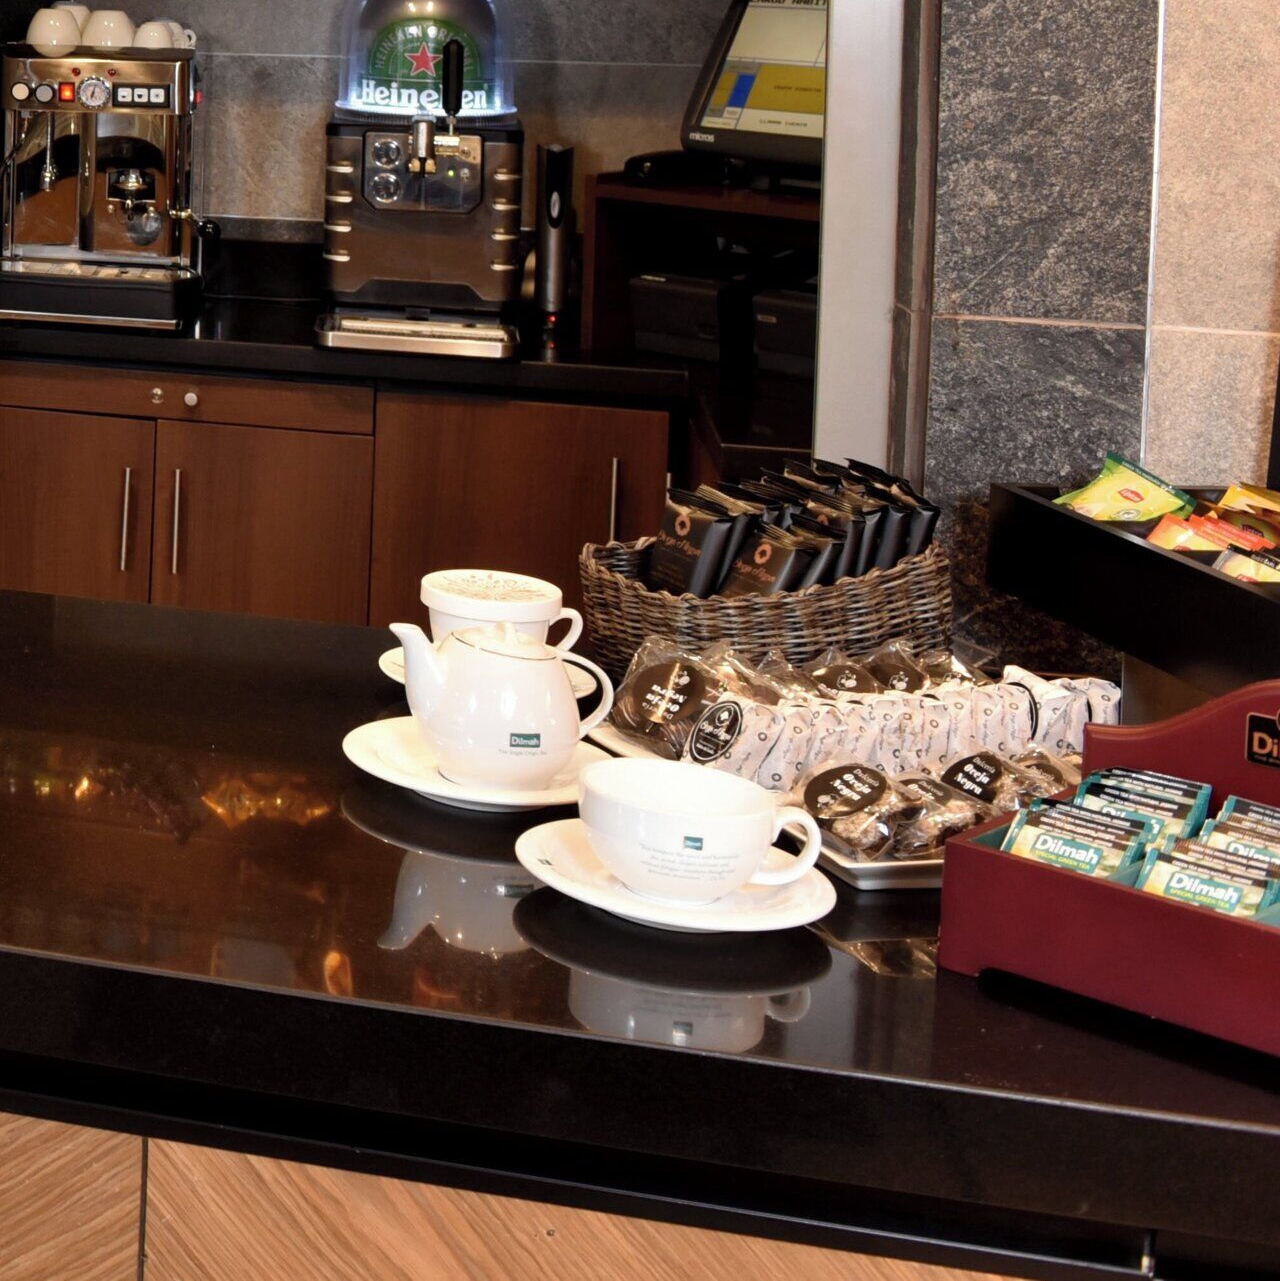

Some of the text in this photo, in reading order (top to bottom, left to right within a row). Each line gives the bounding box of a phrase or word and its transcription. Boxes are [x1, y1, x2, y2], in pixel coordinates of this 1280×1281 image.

[375, 25, 423, 69] HEINEKEN
[362, 79, 487, 109] Heineen
[689, 132, 715, 143] micros
[511, 735, 540, 746] Dilmah
[842, 773, 872, 795] Oreja
[954, 773, 983, 795] Negra
[963, 763, 990, 785] Oreja
[831, 780, 862, 801] Negra
[1034, 834, 1099, 865] Dilmah
[1169, 871, 1241, 904] Dilmah
